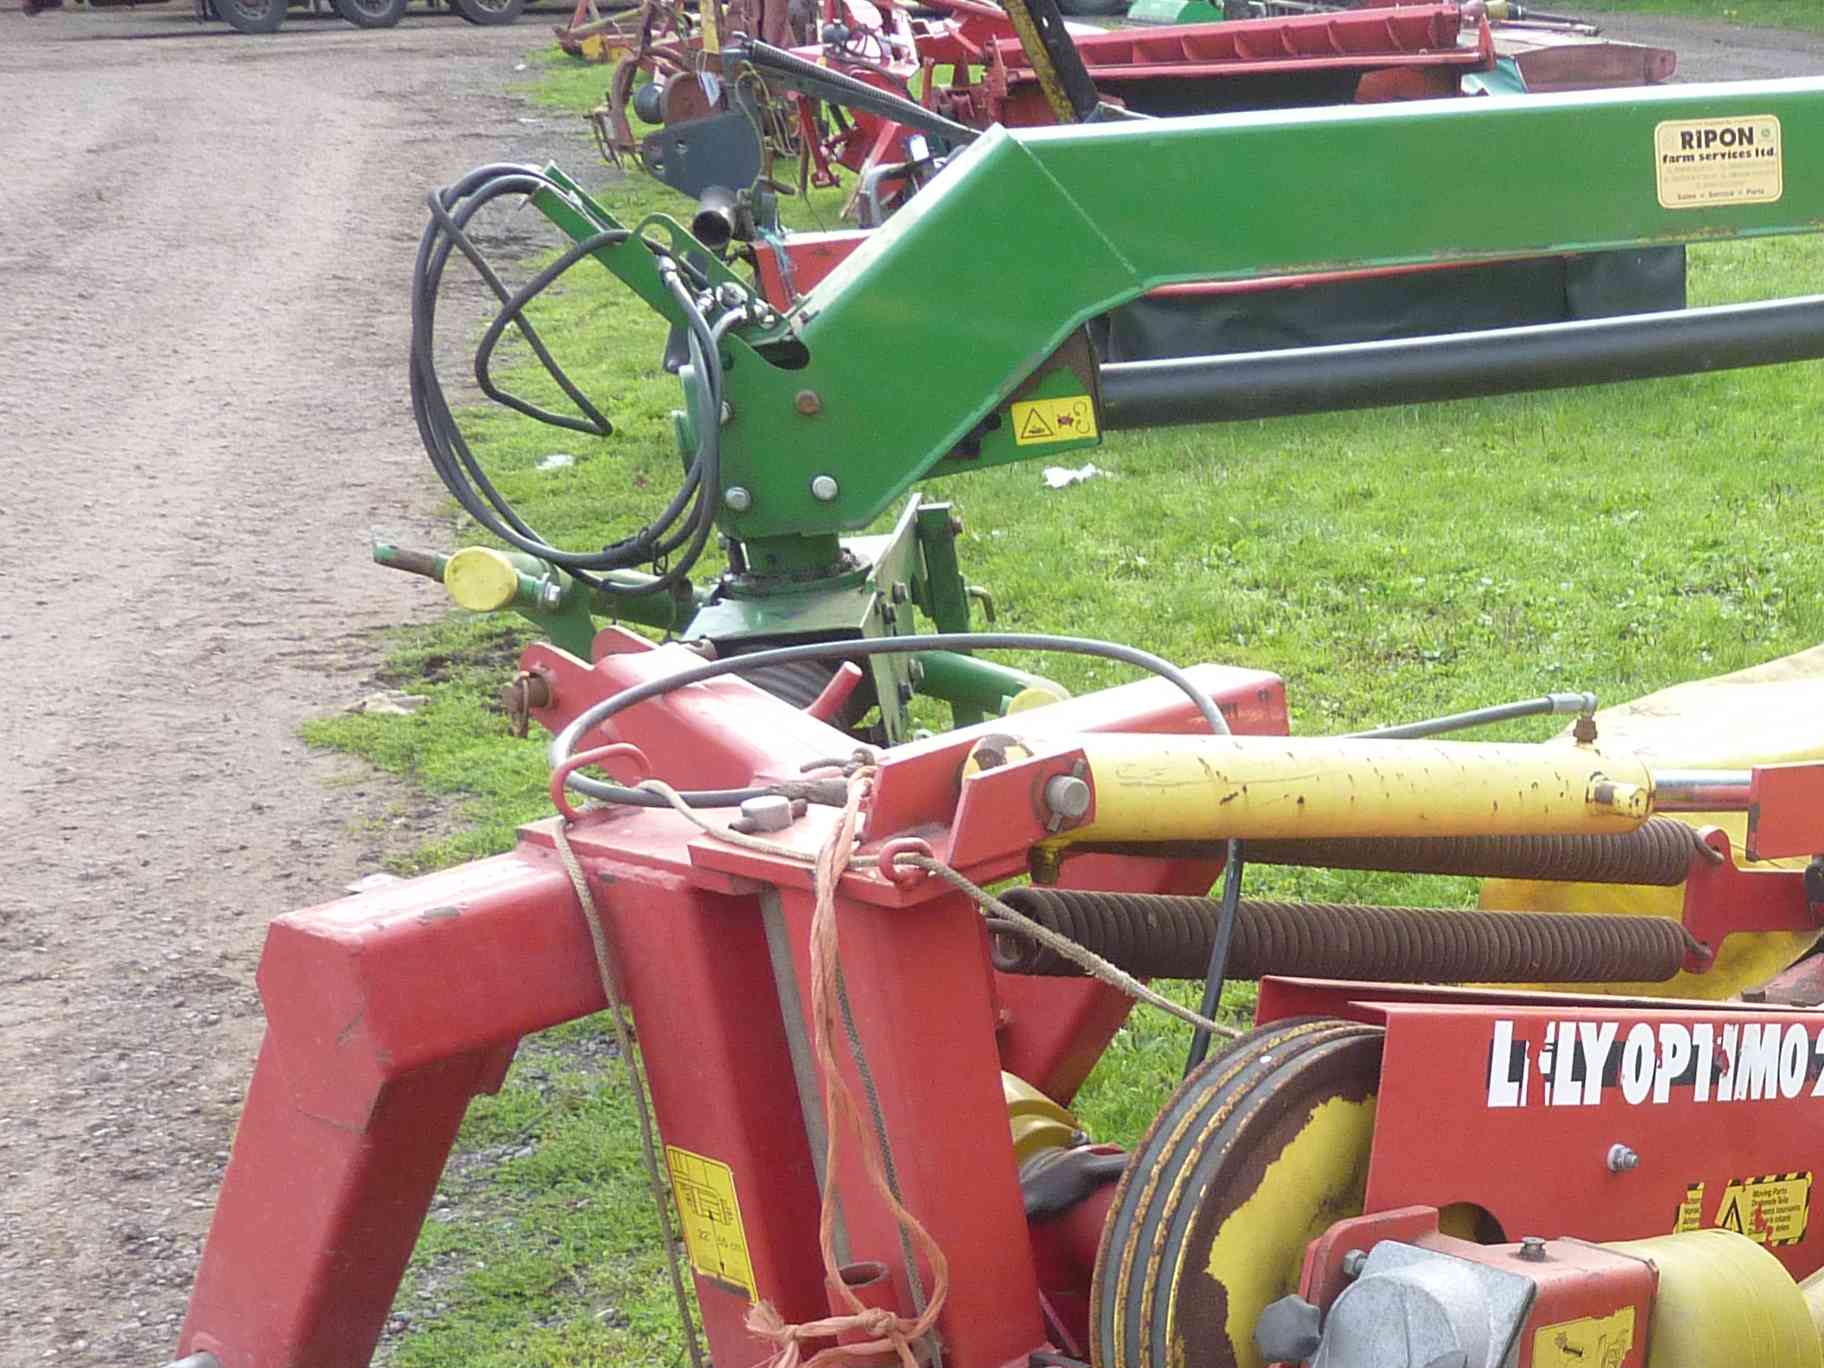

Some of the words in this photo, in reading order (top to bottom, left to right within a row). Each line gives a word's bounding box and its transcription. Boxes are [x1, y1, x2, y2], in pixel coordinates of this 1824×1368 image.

[1680, 126, 1754, 150] RIPON
[1662, 153, 1696, 164] farm
[1698, 149, 1753, 161] services
